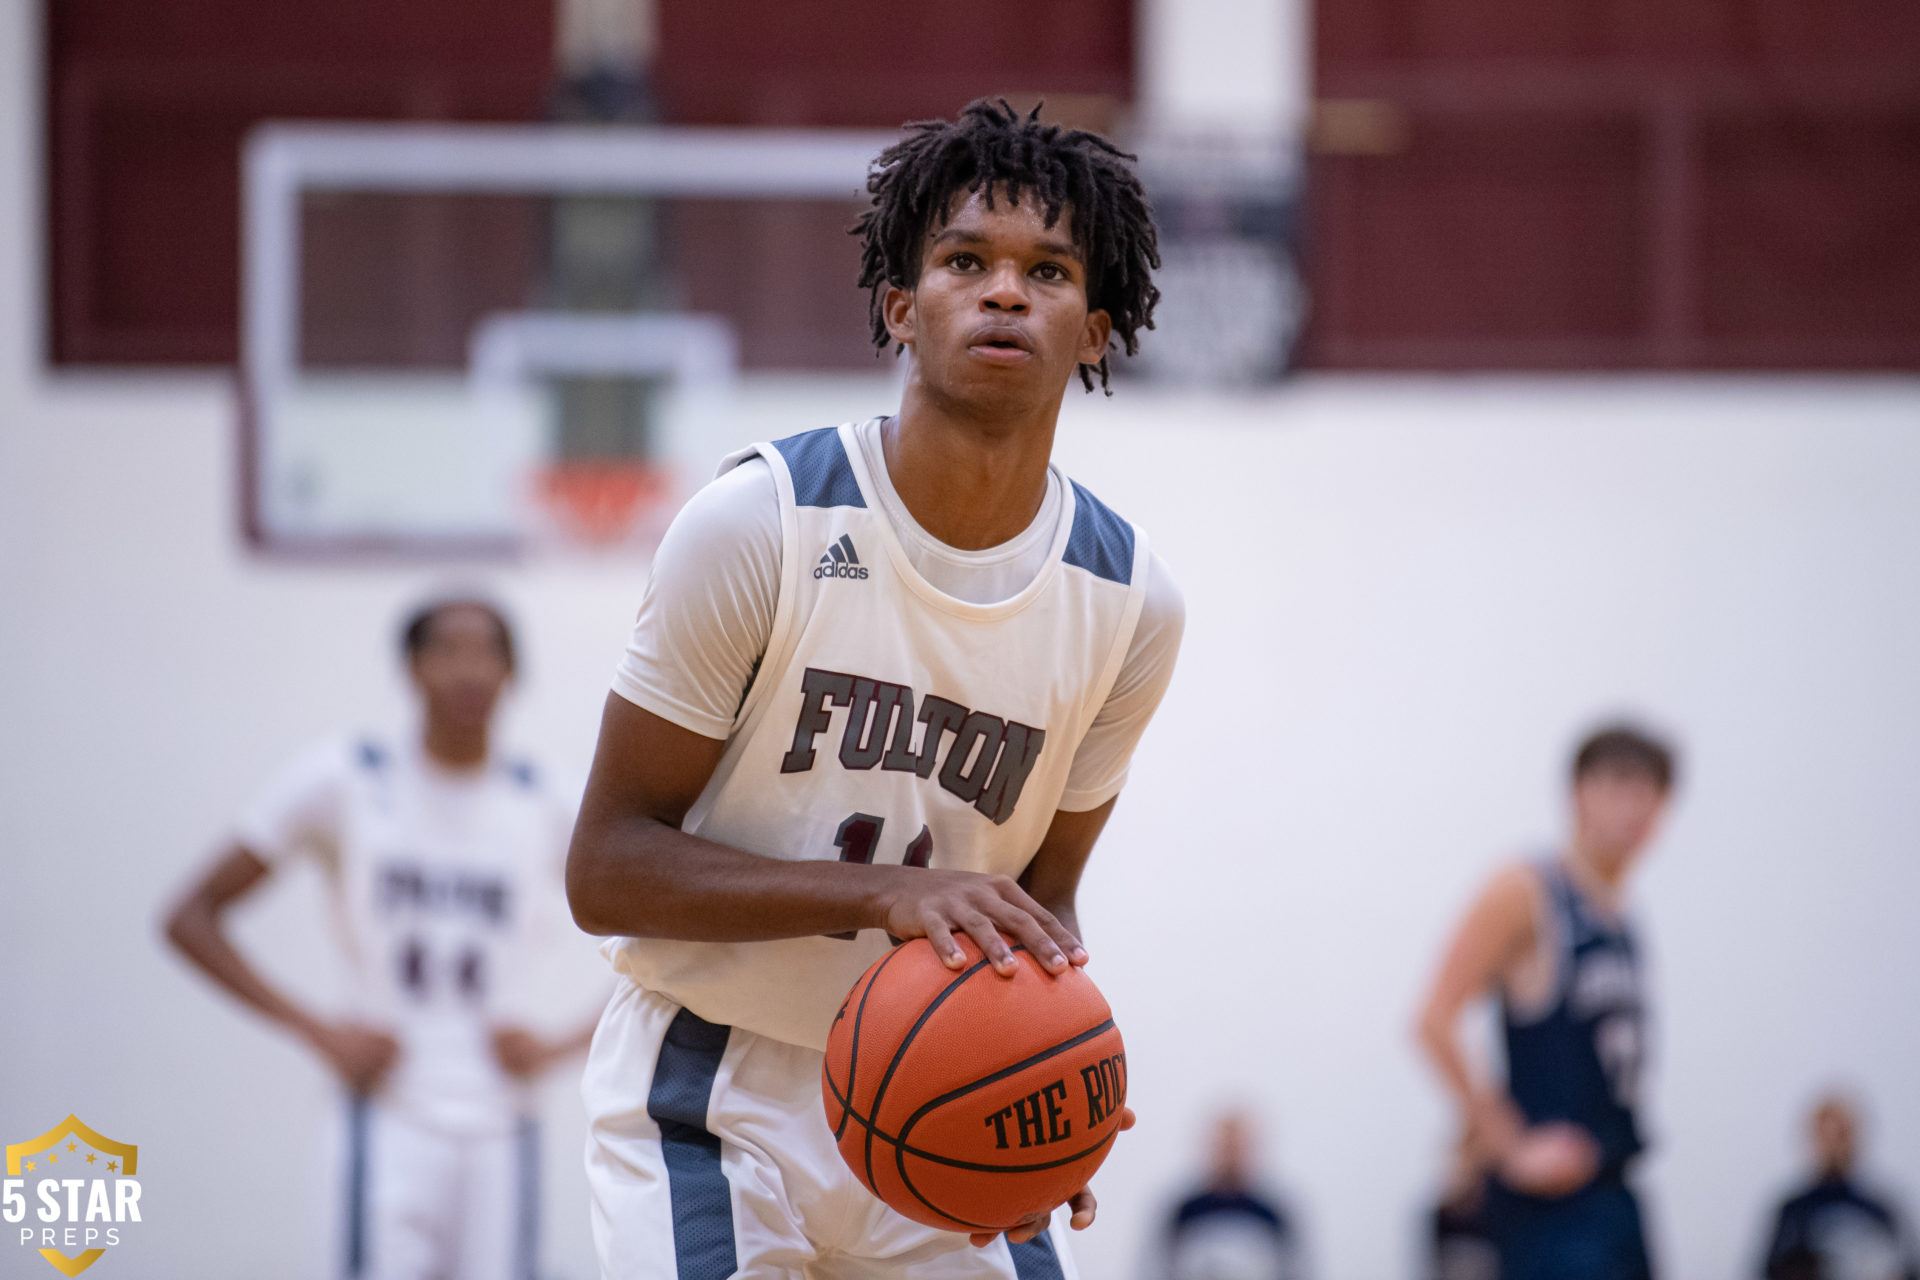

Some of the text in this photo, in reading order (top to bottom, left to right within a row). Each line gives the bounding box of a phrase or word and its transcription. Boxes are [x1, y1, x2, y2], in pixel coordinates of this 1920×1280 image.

[813, 561, 869, 580] adidas
[780, 667, 1046, 826] FULTON
[984, 1079, 1071, 1150] THE
